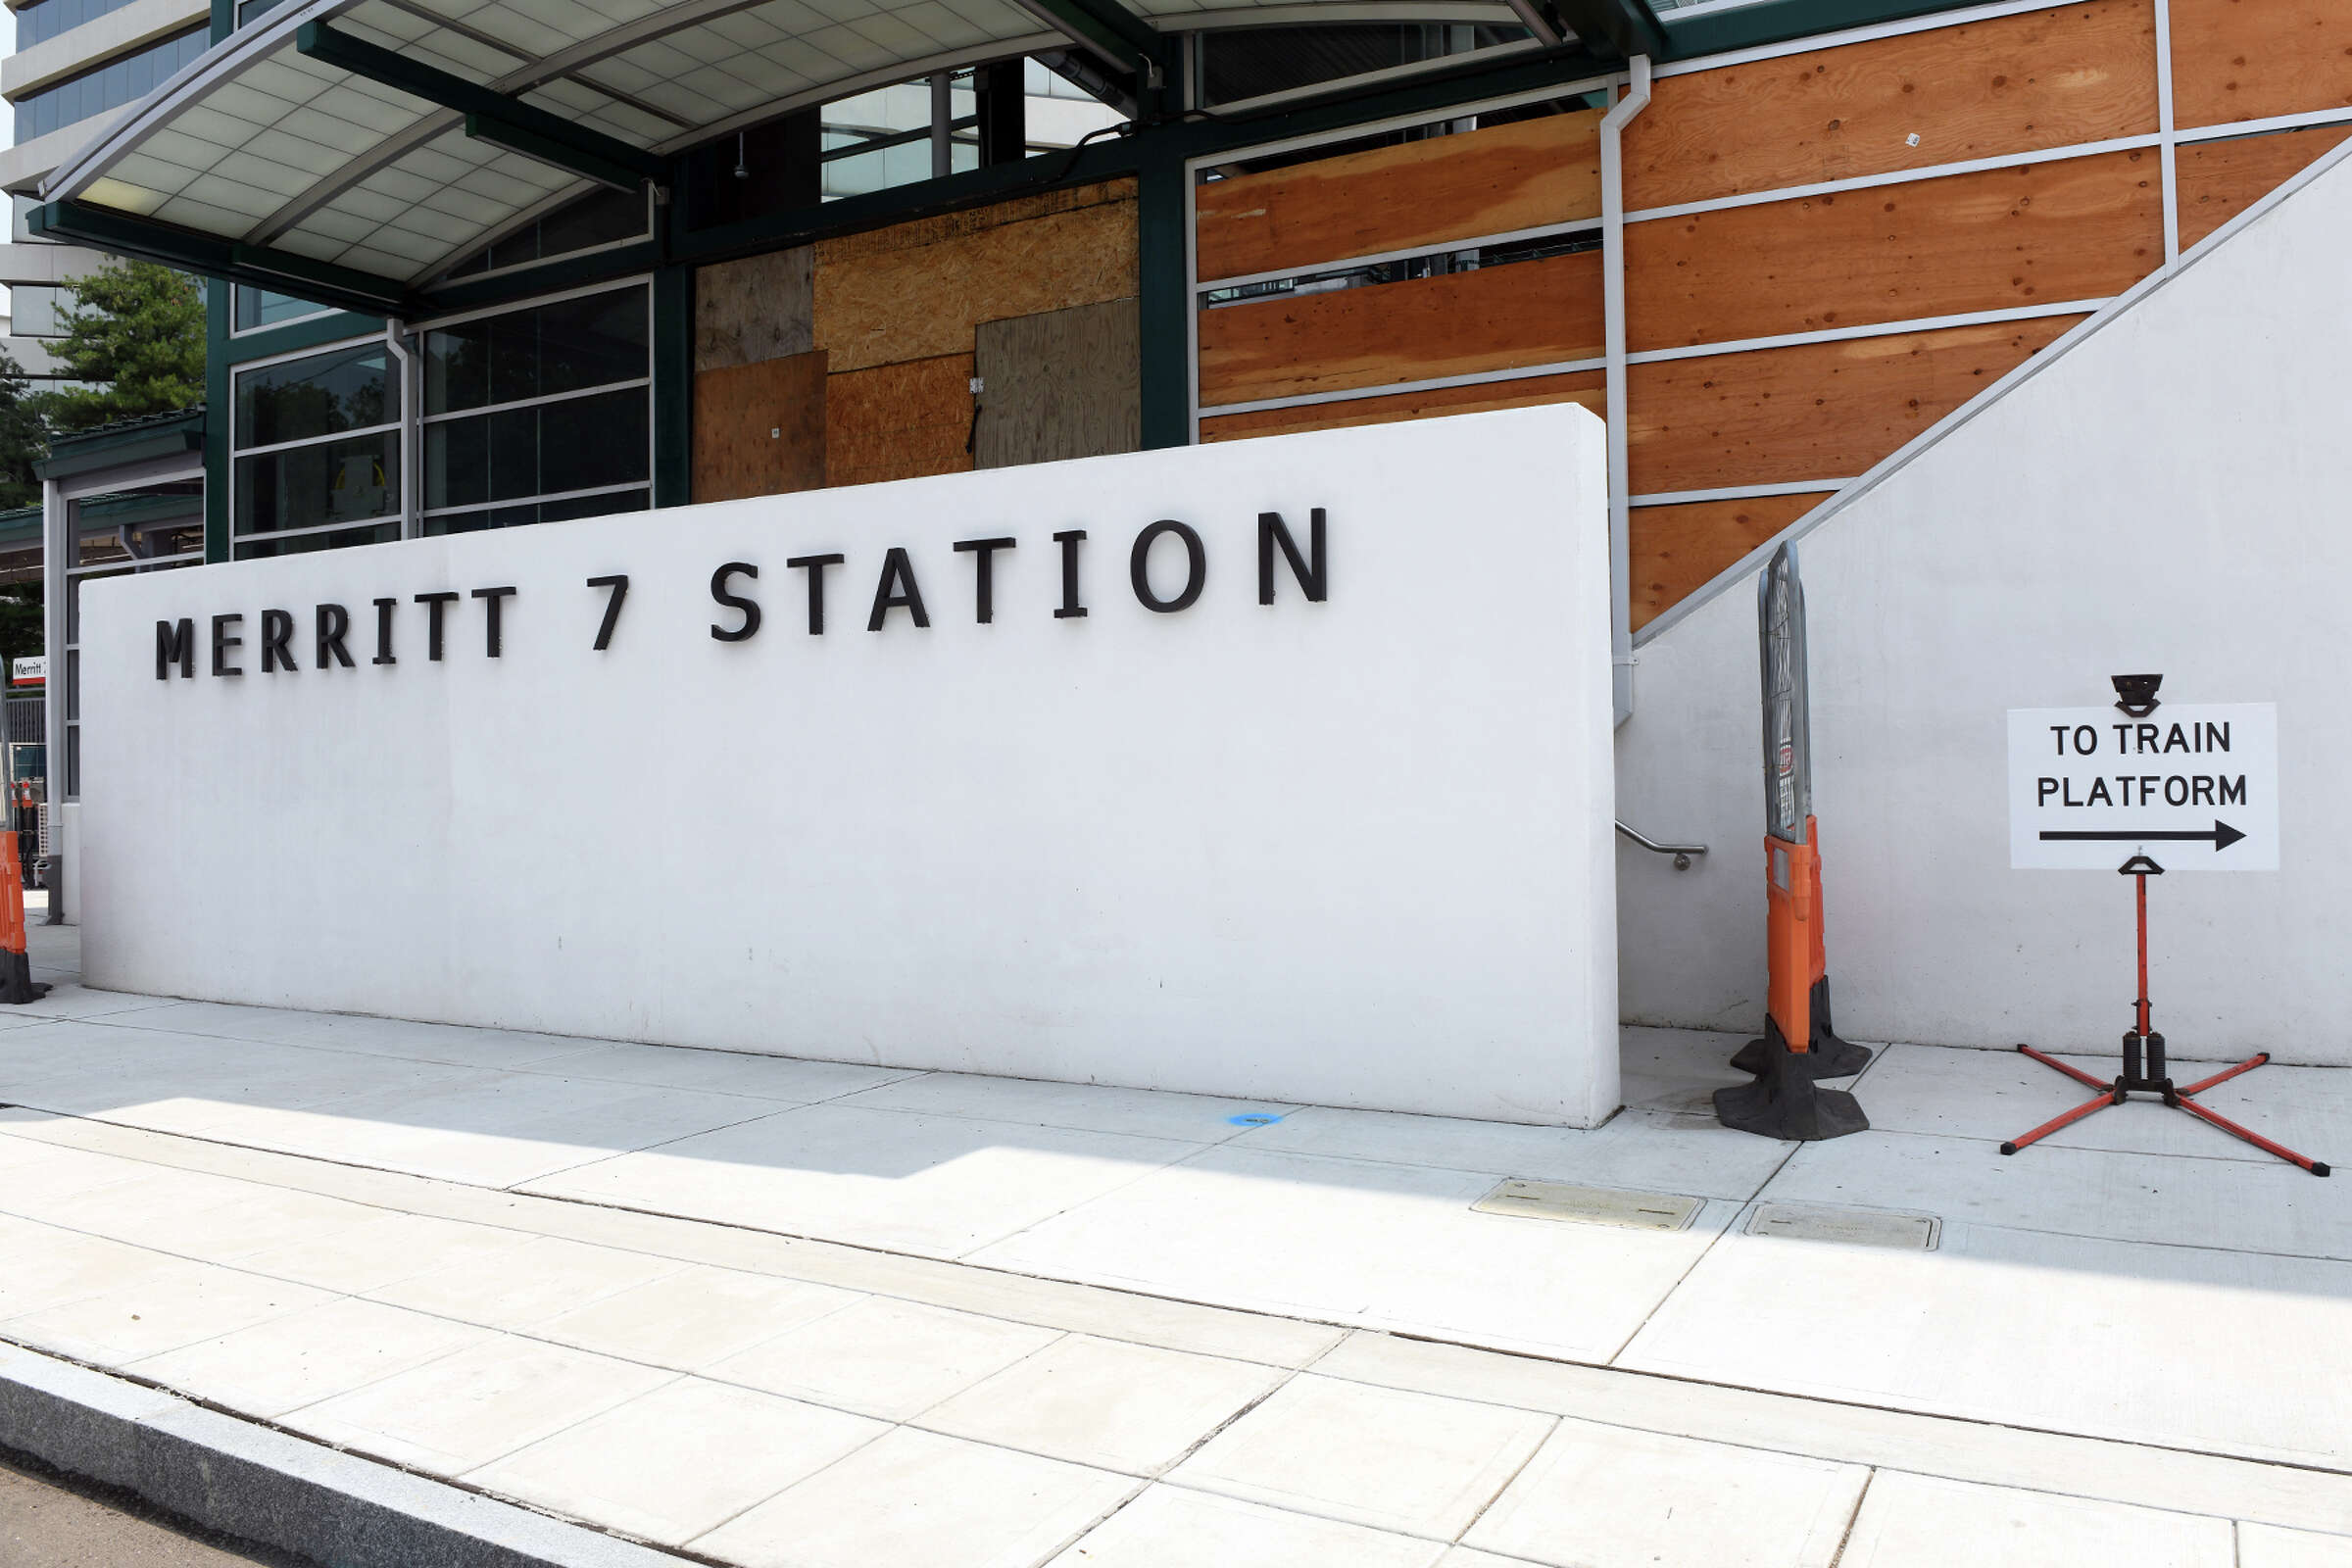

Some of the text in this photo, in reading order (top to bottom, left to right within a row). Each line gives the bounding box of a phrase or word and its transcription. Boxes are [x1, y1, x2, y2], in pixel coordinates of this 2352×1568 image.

[155, 507, 1328, 682] MERRITT 7 STATION
[15, 662, 41, 675] Merritt
[2049, 721, 2231, 756] TO TRAIN
[2037, 774, 2247, 808] PLATFORM
